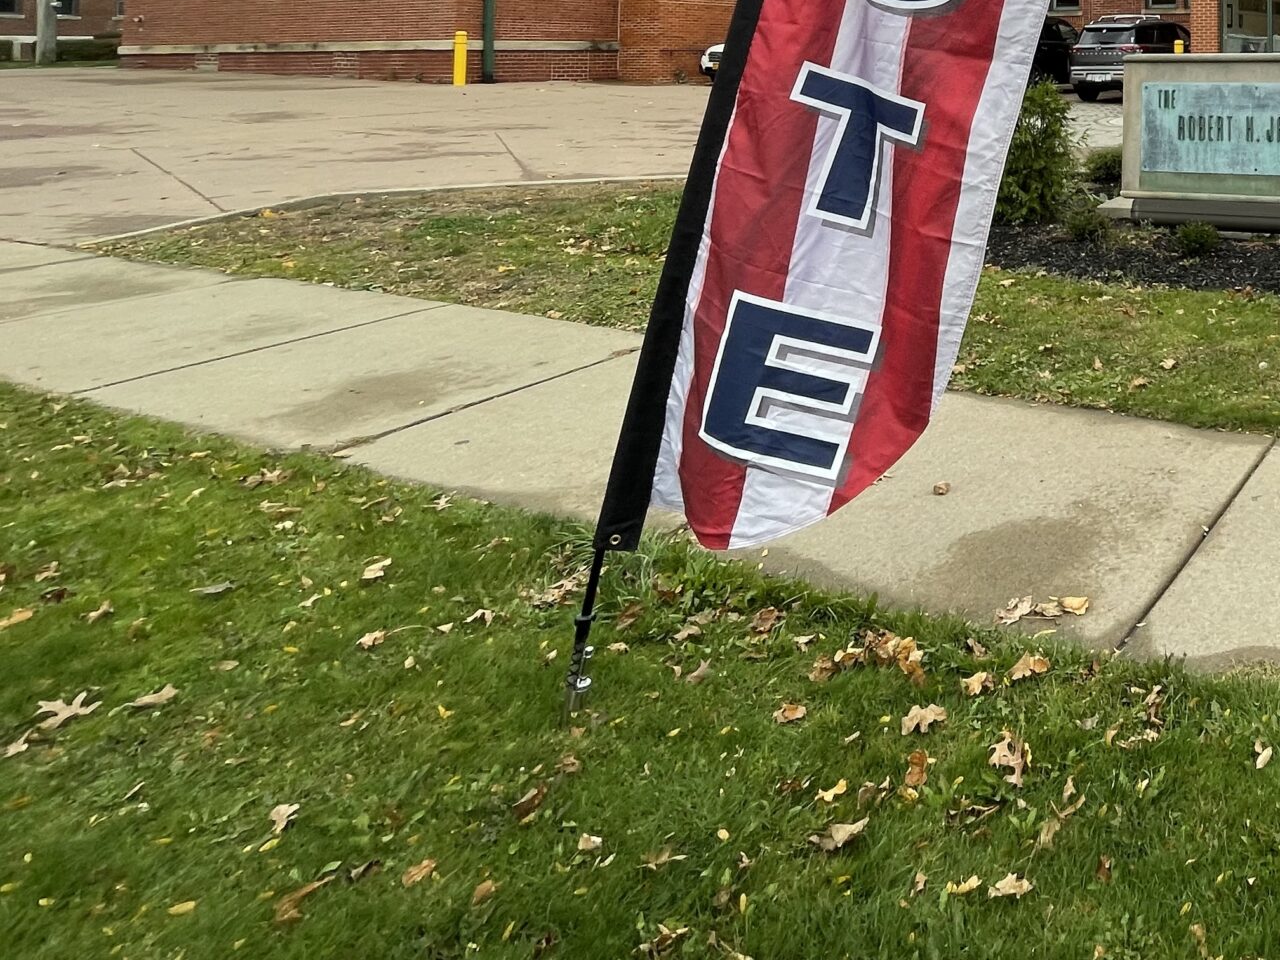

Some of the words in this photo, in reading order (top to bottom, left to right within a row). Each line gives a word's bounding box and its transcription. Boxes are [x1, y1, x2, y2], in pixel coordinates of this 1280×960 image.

[1158, 89, 1176, 109] THE
[1178, 115, 1233, 142] ROBERT
[1246, 116, 1260, 143] H.
